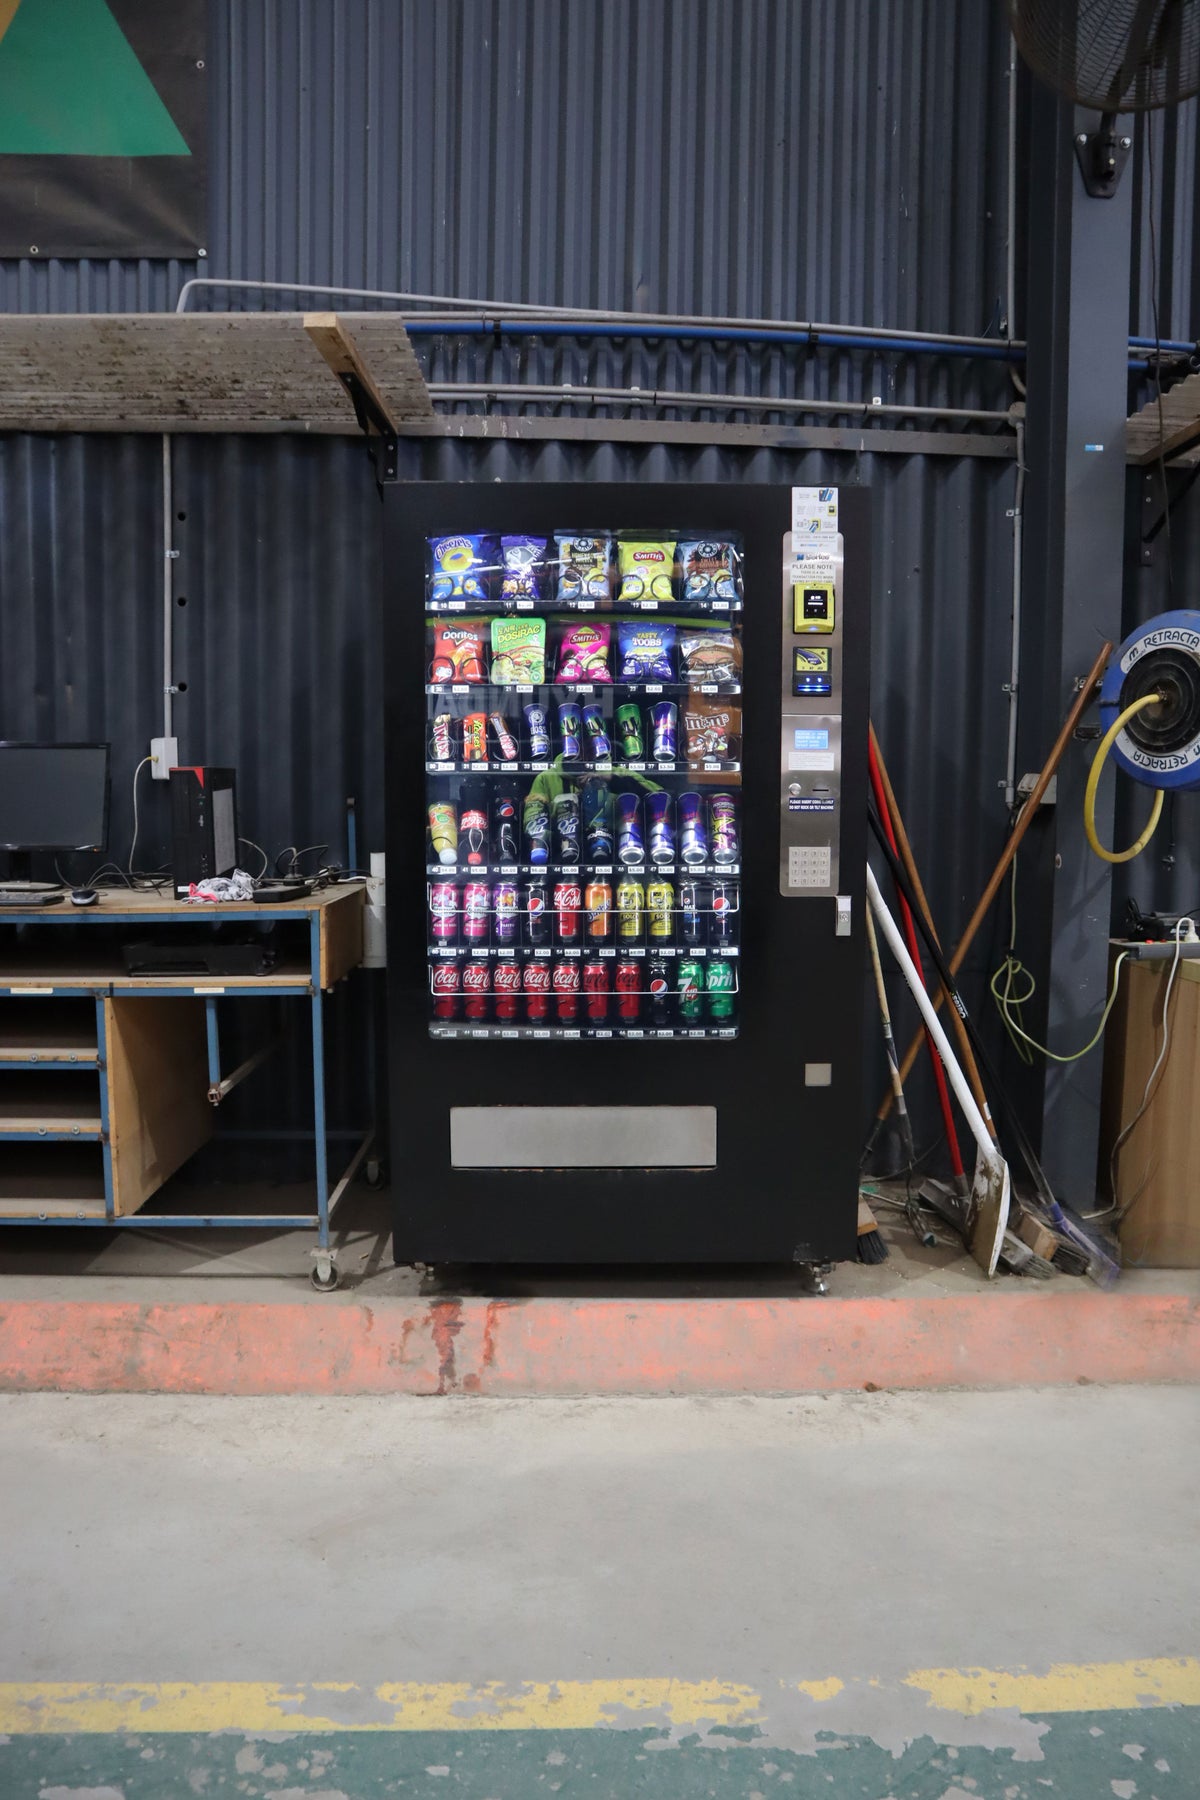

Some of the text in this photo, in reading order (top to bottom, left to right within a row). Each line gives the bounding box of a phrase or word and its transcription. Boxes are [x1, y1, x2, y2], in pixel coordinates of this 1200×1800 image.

[435, 536, 472, 560] Cheezels
[634, 552, 664, 561] SMITH'S
[442, 631, 479, 641] Doritos
[571, 633, 599, 643] SMITH'S
[1144, 631, 1200, 648] RETRACTA
[632, 637, 662, 647] TOOBS
[1133, 751, 1189, 770] RETRACTA
